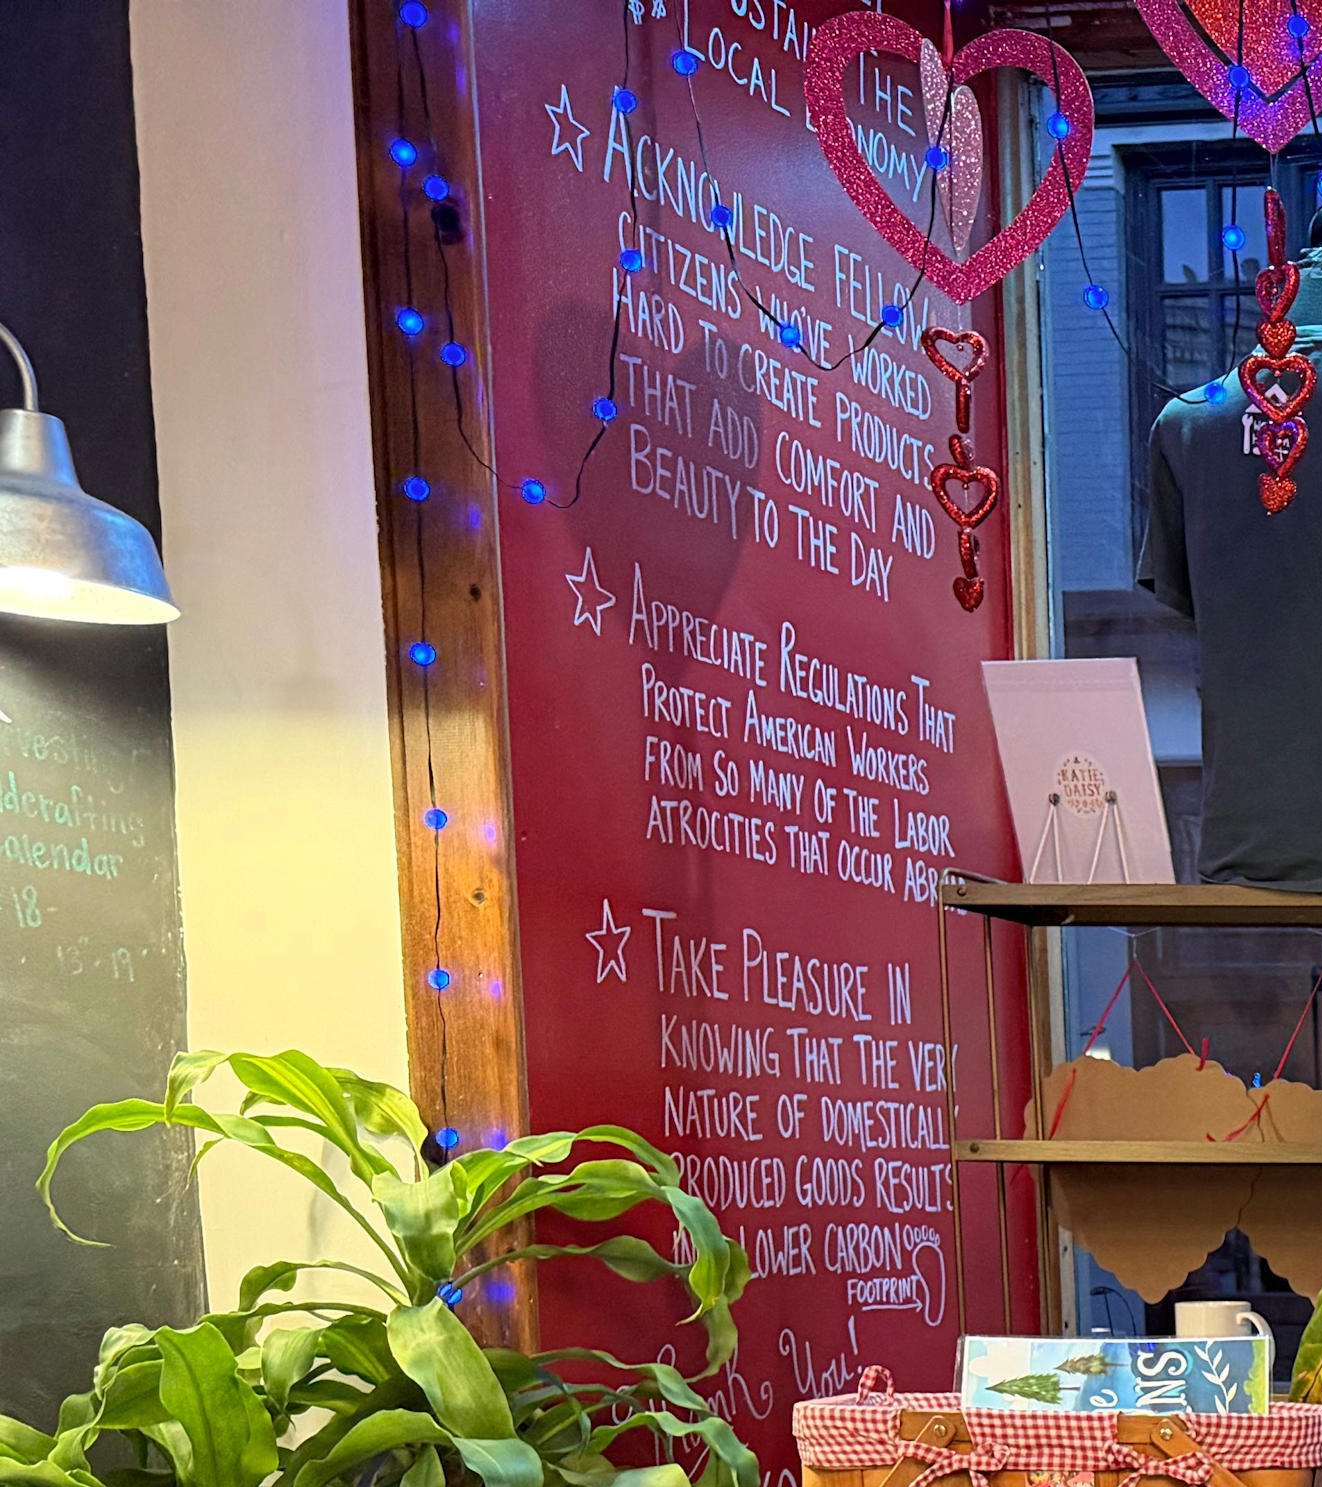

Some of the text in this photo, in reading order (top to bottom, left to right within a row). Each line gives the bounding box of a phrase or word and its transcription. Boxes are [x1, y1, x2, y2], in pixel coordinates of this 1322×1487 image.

[684, 0, 791, 117] LOCAL
[604, 86, 929, 356] ACKNOWLEDGE FELLOW
[618, 211, 742, 320] CITIZENS
[849, 335, 930, 421] WORKED
[612, 267, 936, 491] HARD TO CREATE PRODUCTS
[620, 354, 936, 559] THAT ADD COMFORT AND
[630, 424, 894, 602] BEAUTY TO THE DAY
[629, 562, 955, 753] APPRECIATE REGULATIONS THAT
[641, 663, 930, 796] PROTECT AMERICAN WORKERS
[0, 833, 124, 880] alendar
[645, 737, 956, 858] FROM SO MANY OF THE LABOR
[646, 796, 967, 916] ATROCITIES THAT OCCUR ABR
[642, 908, 911, 1025] TAKE PLEASURE IN
[661, 1014, 780, 1079] KNOWING
[786, 1027, 843, 1085] THAT
[852, 1034, 899, 1089] THE
[664, 1086, 959, 1152] NATURE OF DOMESTICALL
[796, 1156, 865, 1209] GOODS
[875, 1157, 954, 1214] RESULTS
[824, 1222, 902, 1274] CARBON
[847, 1273, 919, 1306] FOOTPRINT
[779, 1315, 864, 1399] You!
